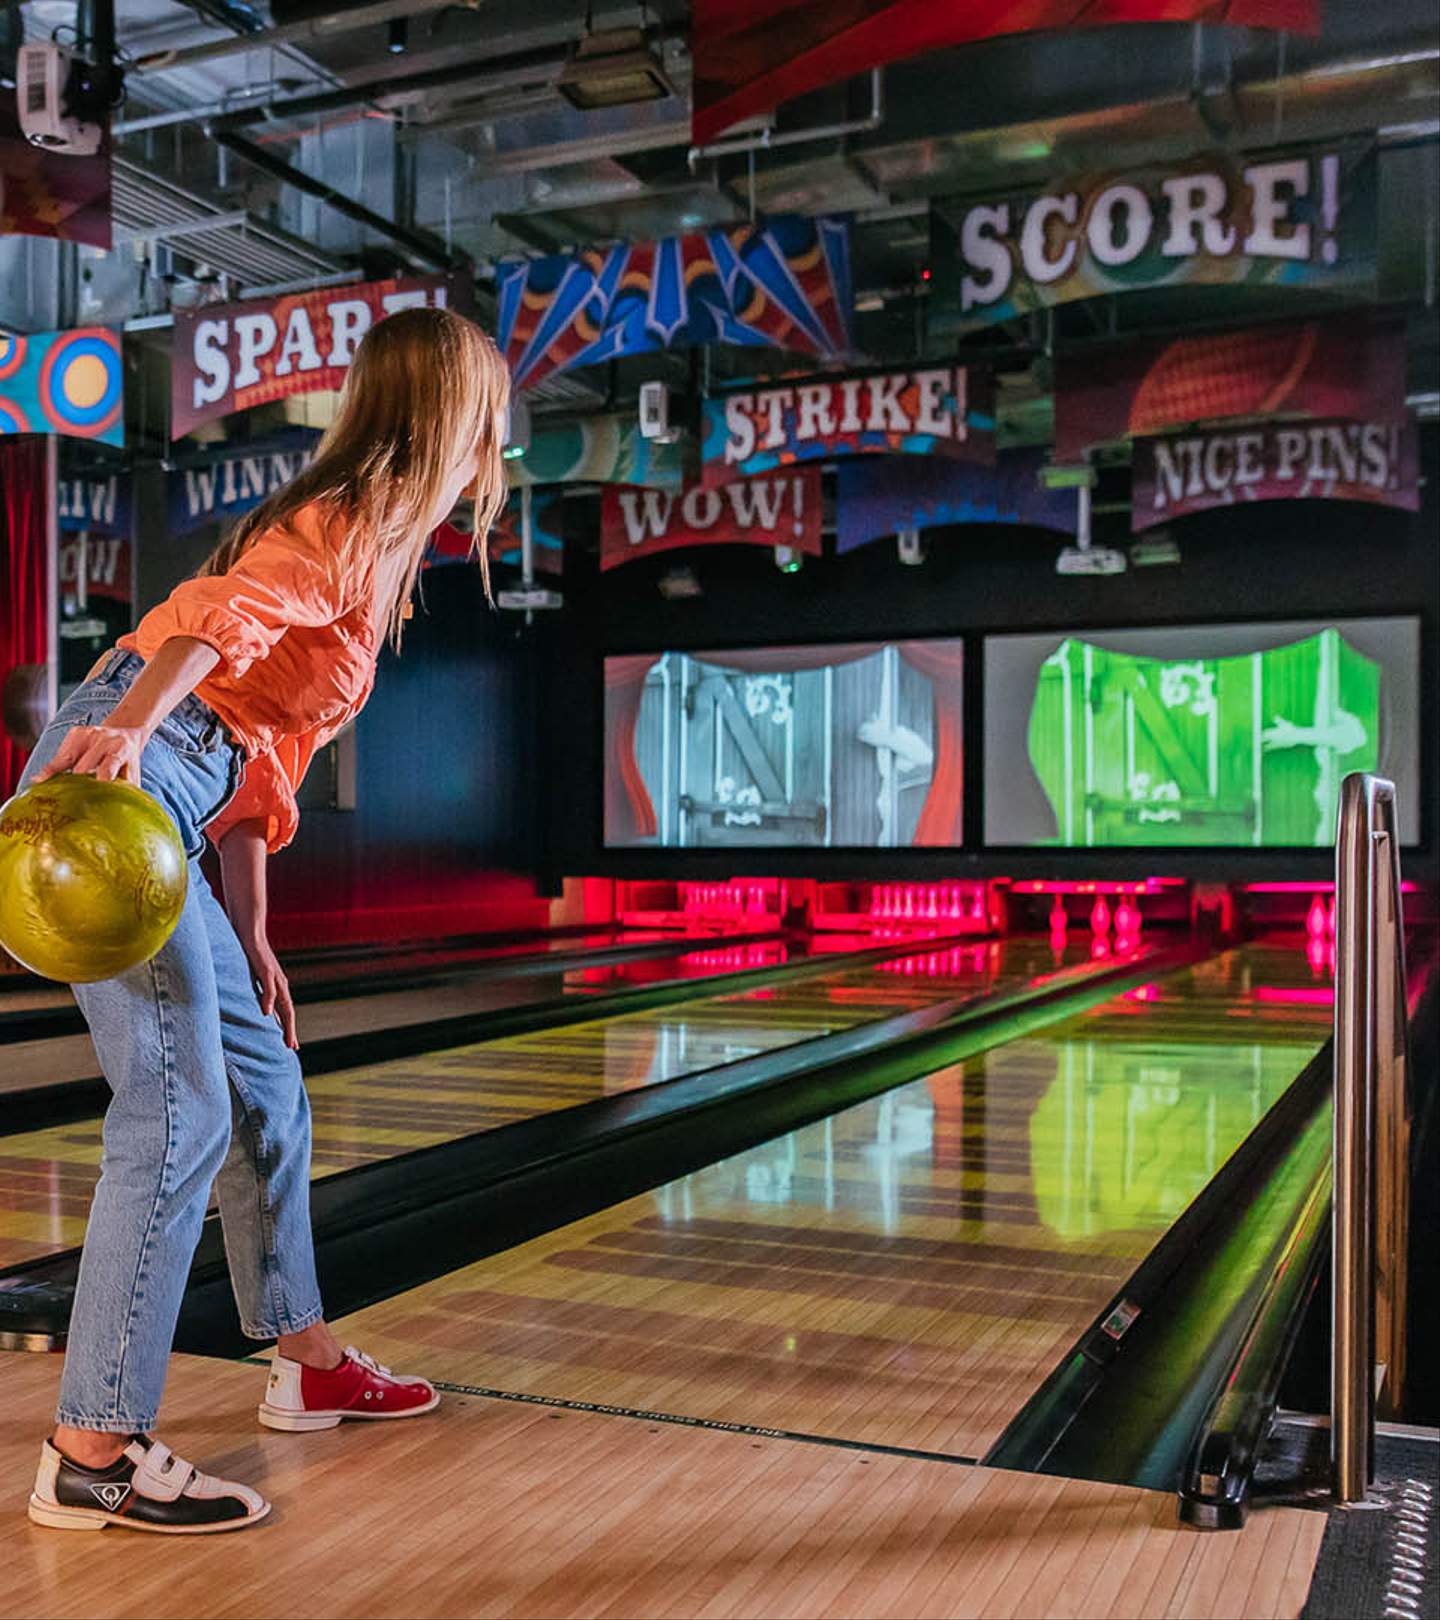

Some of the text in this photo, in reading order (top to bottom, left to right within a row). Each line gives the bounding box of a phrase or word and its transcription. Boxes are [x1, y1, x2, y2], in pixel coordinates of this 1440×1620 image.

[961, 156, 1340, 312] SCORE!
[724, 367, 968, 464] STRIKE!
[186, 451, 312, 516] WINN
[1154, 423, 1399, 508] NICE PINS!
[619, 477, 804, 546] WOW!
